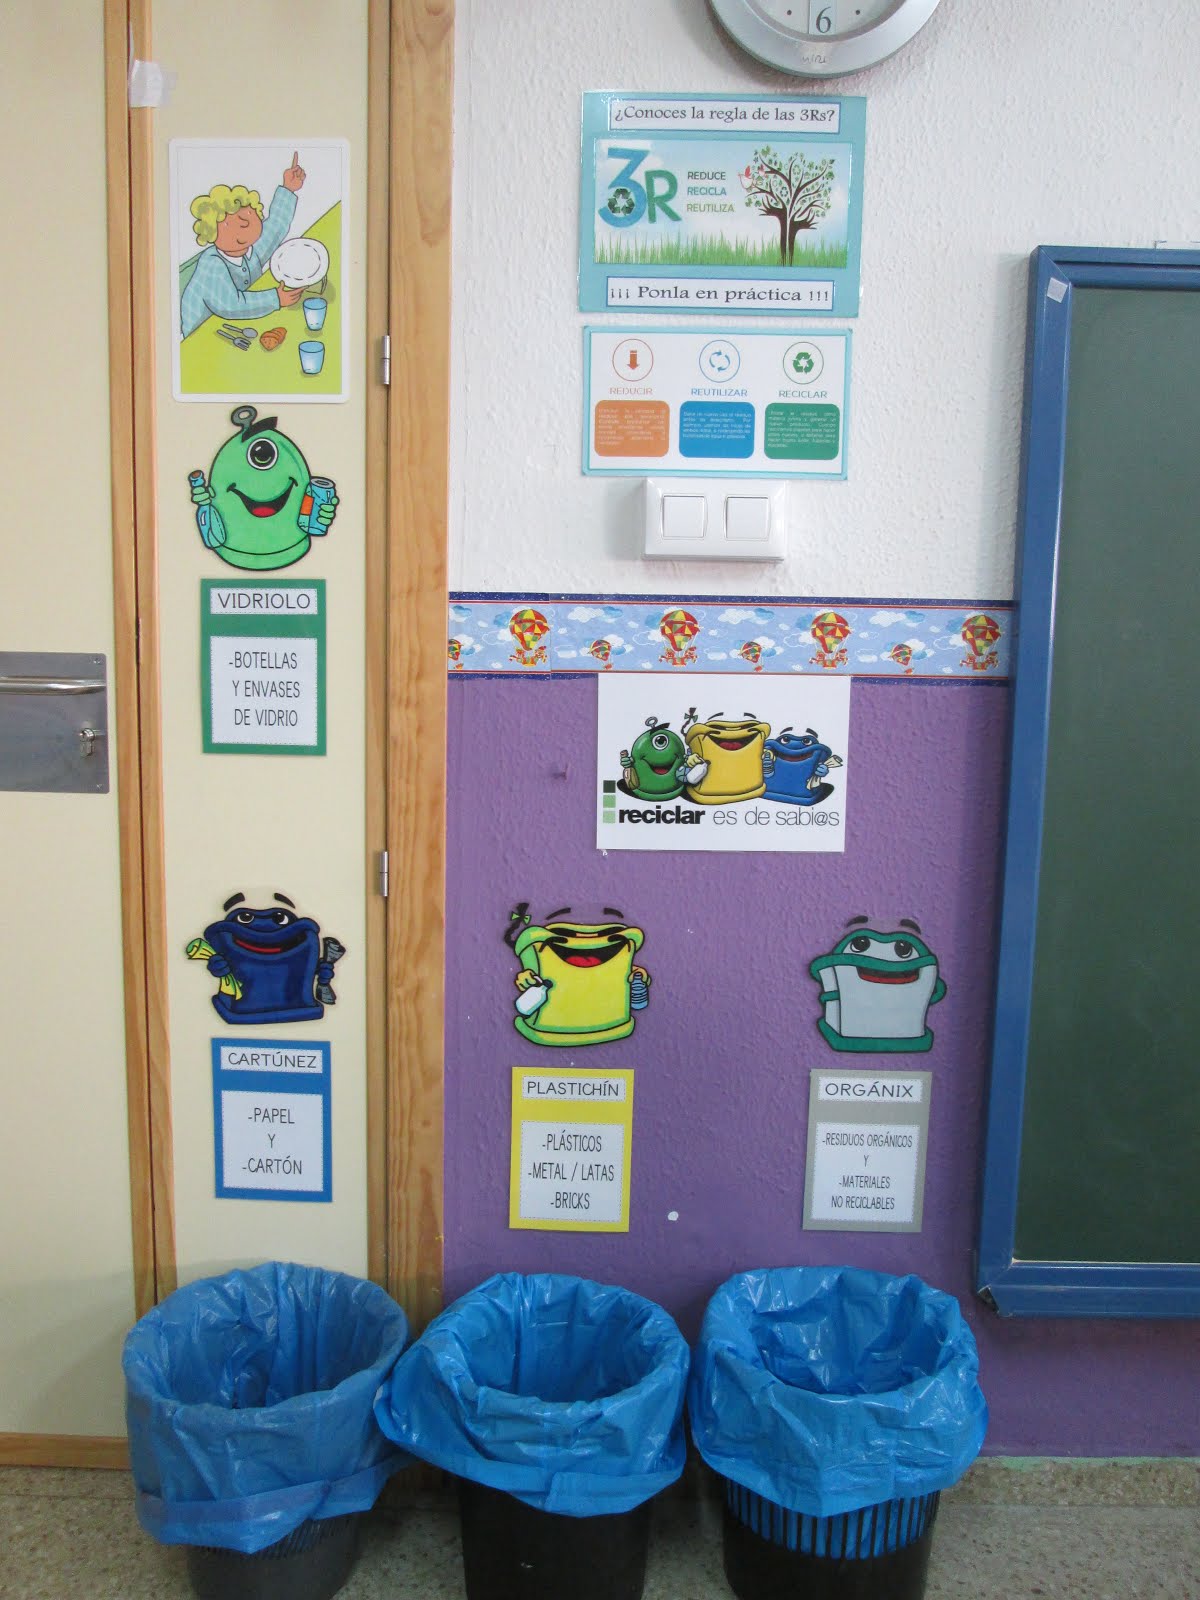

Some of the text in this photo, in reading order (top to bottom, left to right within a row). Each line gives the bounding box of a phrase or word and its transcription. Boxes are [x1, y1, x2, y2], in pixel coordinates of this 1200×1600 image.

[815, 6, 833, 34] 6
[614, 105, 836, 124] ¿Conoces la regla de las 3Rs?
[687, 171, 726, 180] REDUCE
[597, 147, 682, 228] 3R
[687, 187, 727, 196] RECICLA
[686, 203, 735, 213] REUTILIZA
[637, 286, 690, 299] Ponla
[695, 289, 718, 300] en
[725, 287, 802, 303] práctica
[809, 290, 828, 302] !!!
[609, 387, 653, 396] REDUCIR
[691, 388, 748, 397] REUTILIZAR
[778, 390, 828, 399] RECICLAR
[217, 593, 311, 609] VIDRIOLO
[228, 651, 298, 669] -BOTELLAS
[232, 680, 301, 698] Y ENVASES
[234, 708, 298, 727] DE VIDRIO
[618, 804, 840, 827] reciclar es de sabi@s
[228, 1051, 317, 1069] CARTÚNEZ
[527, 1080, 619, 1096] PLASTICHÍN
[825, 1081, 914, 1098] ORGÁNIX
[248, 1107, 295, 1124] -PAPEL
[267, 1133, 276, 1149] Y
[542, 1129, 602, 1153] -PLÁSTICOS
[822, 1131, 913, 1148] -RESIDUOS ORGÁNICOS
[242, 1155, 302, 1175] -CARTÓN
[863, 1154, 869, 1167] Y
[528, 1162, 567, 1180] -METAL
[581, 1164, 614, 1182] LATAS
[838, 1175, 891, 1189] -MATERIALES
[550, 1191, 590, 1210] -BRICKS
[831, 1196, 895, 1210] NO RECICLABLES
